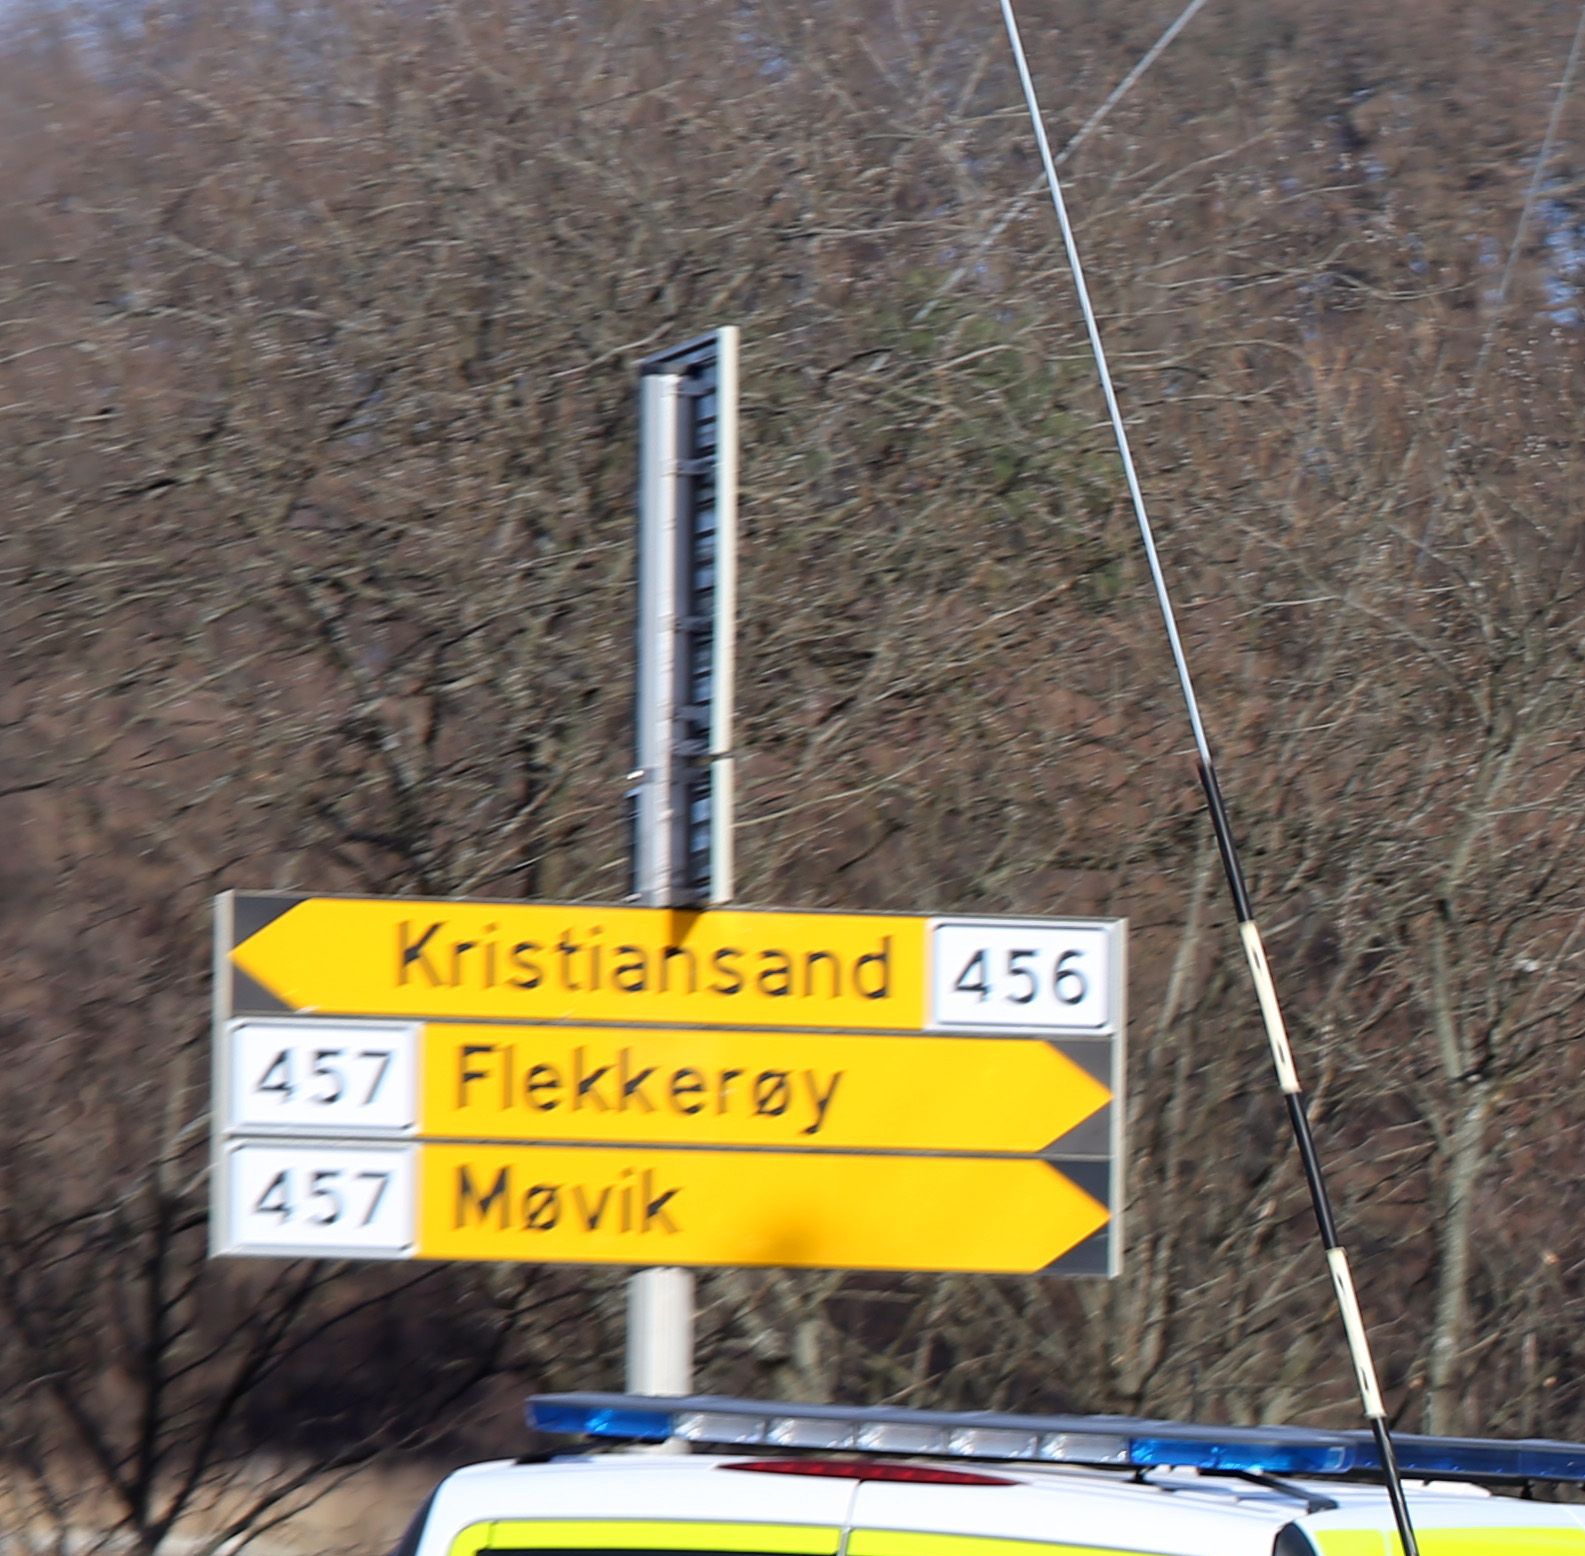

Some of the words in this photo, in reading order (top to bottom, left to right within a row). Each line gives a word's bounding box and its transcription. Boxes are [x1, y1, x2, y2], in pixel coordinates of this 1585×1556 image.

[394, 921, 893, 1001] Kristiansand
[953, 947, 1091, 1005] 456
[254, 1047, 394, 1108] 457
[455, 1044, 845, 1136] Flekkerøy
[253, 1168, 392, 1230] 457
[451, 1164, 687, 1236] Møvik
